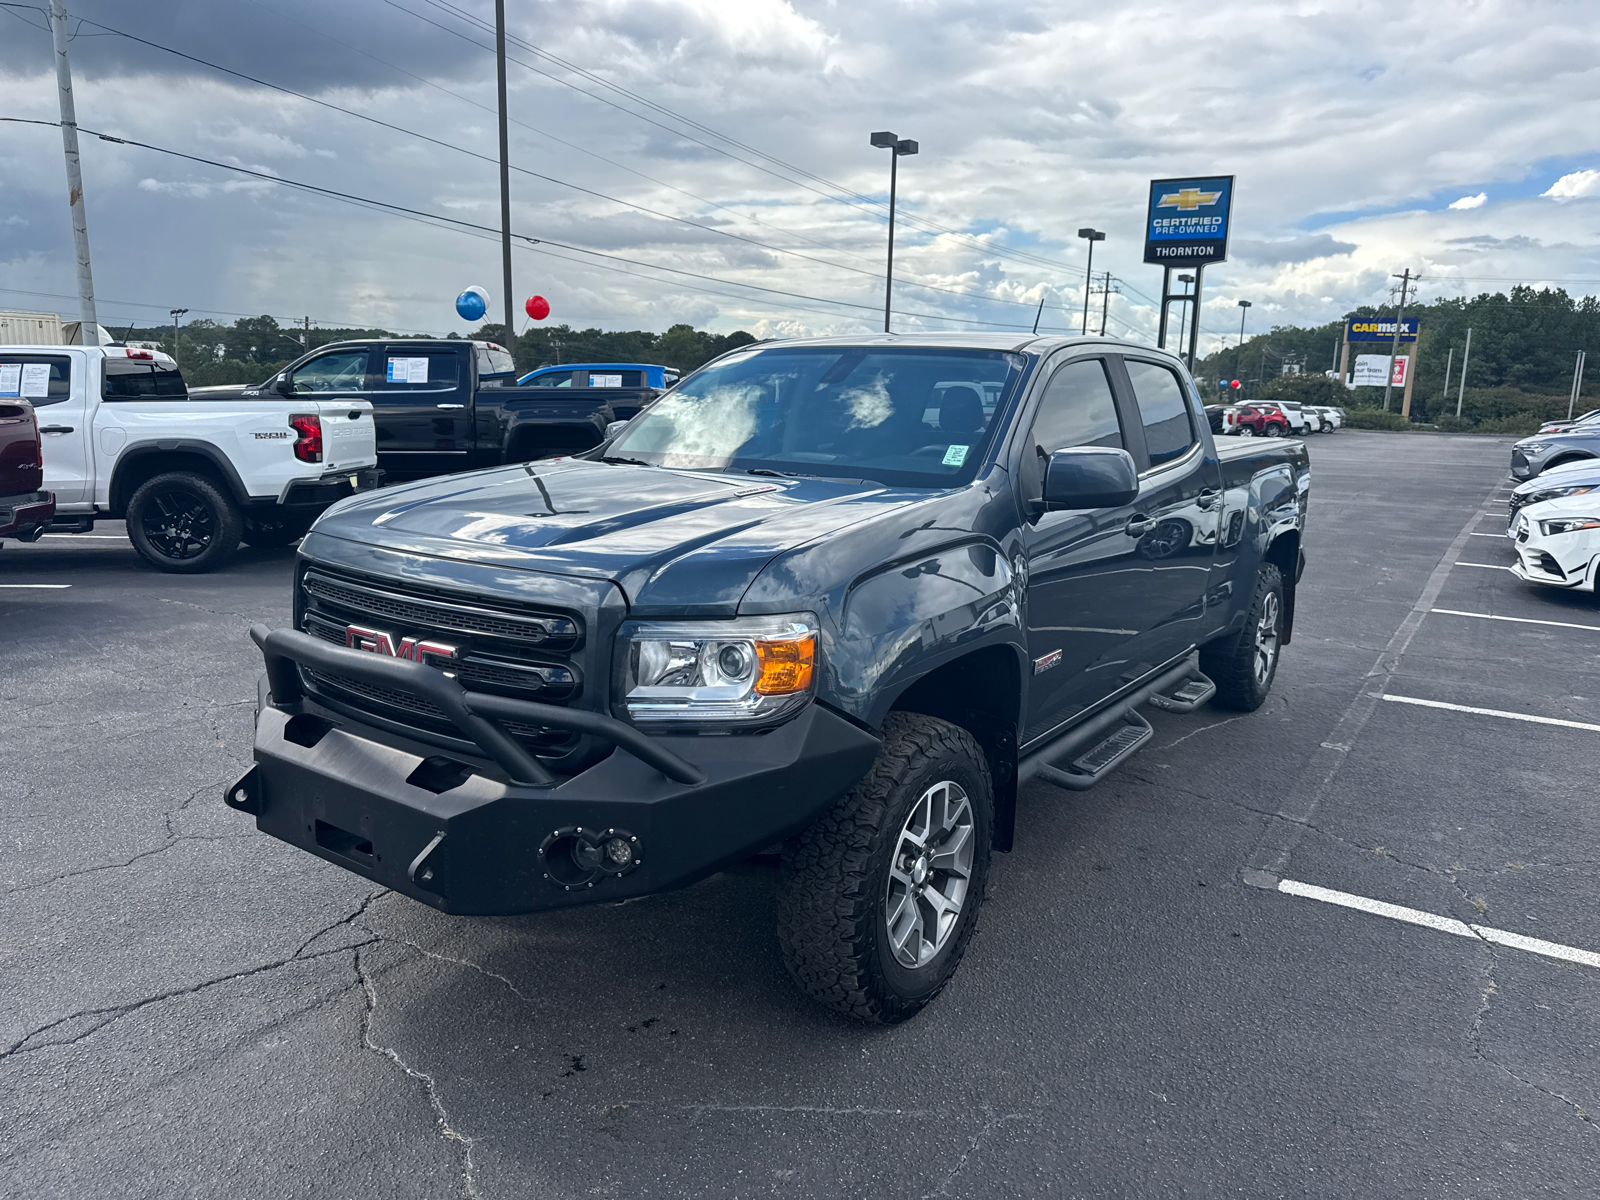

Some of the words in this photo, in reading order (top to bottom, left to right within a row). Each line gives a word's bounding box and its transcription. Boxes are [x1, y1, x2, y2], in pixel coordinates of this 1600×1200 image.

[1153, 216, 1222, 227] CERTIFIED
[1155, 225, 1218, 234] PRE-OWNED
[1156, 246, 1214, 256] THORNTON
[346, 624, 459, 677] GMC
